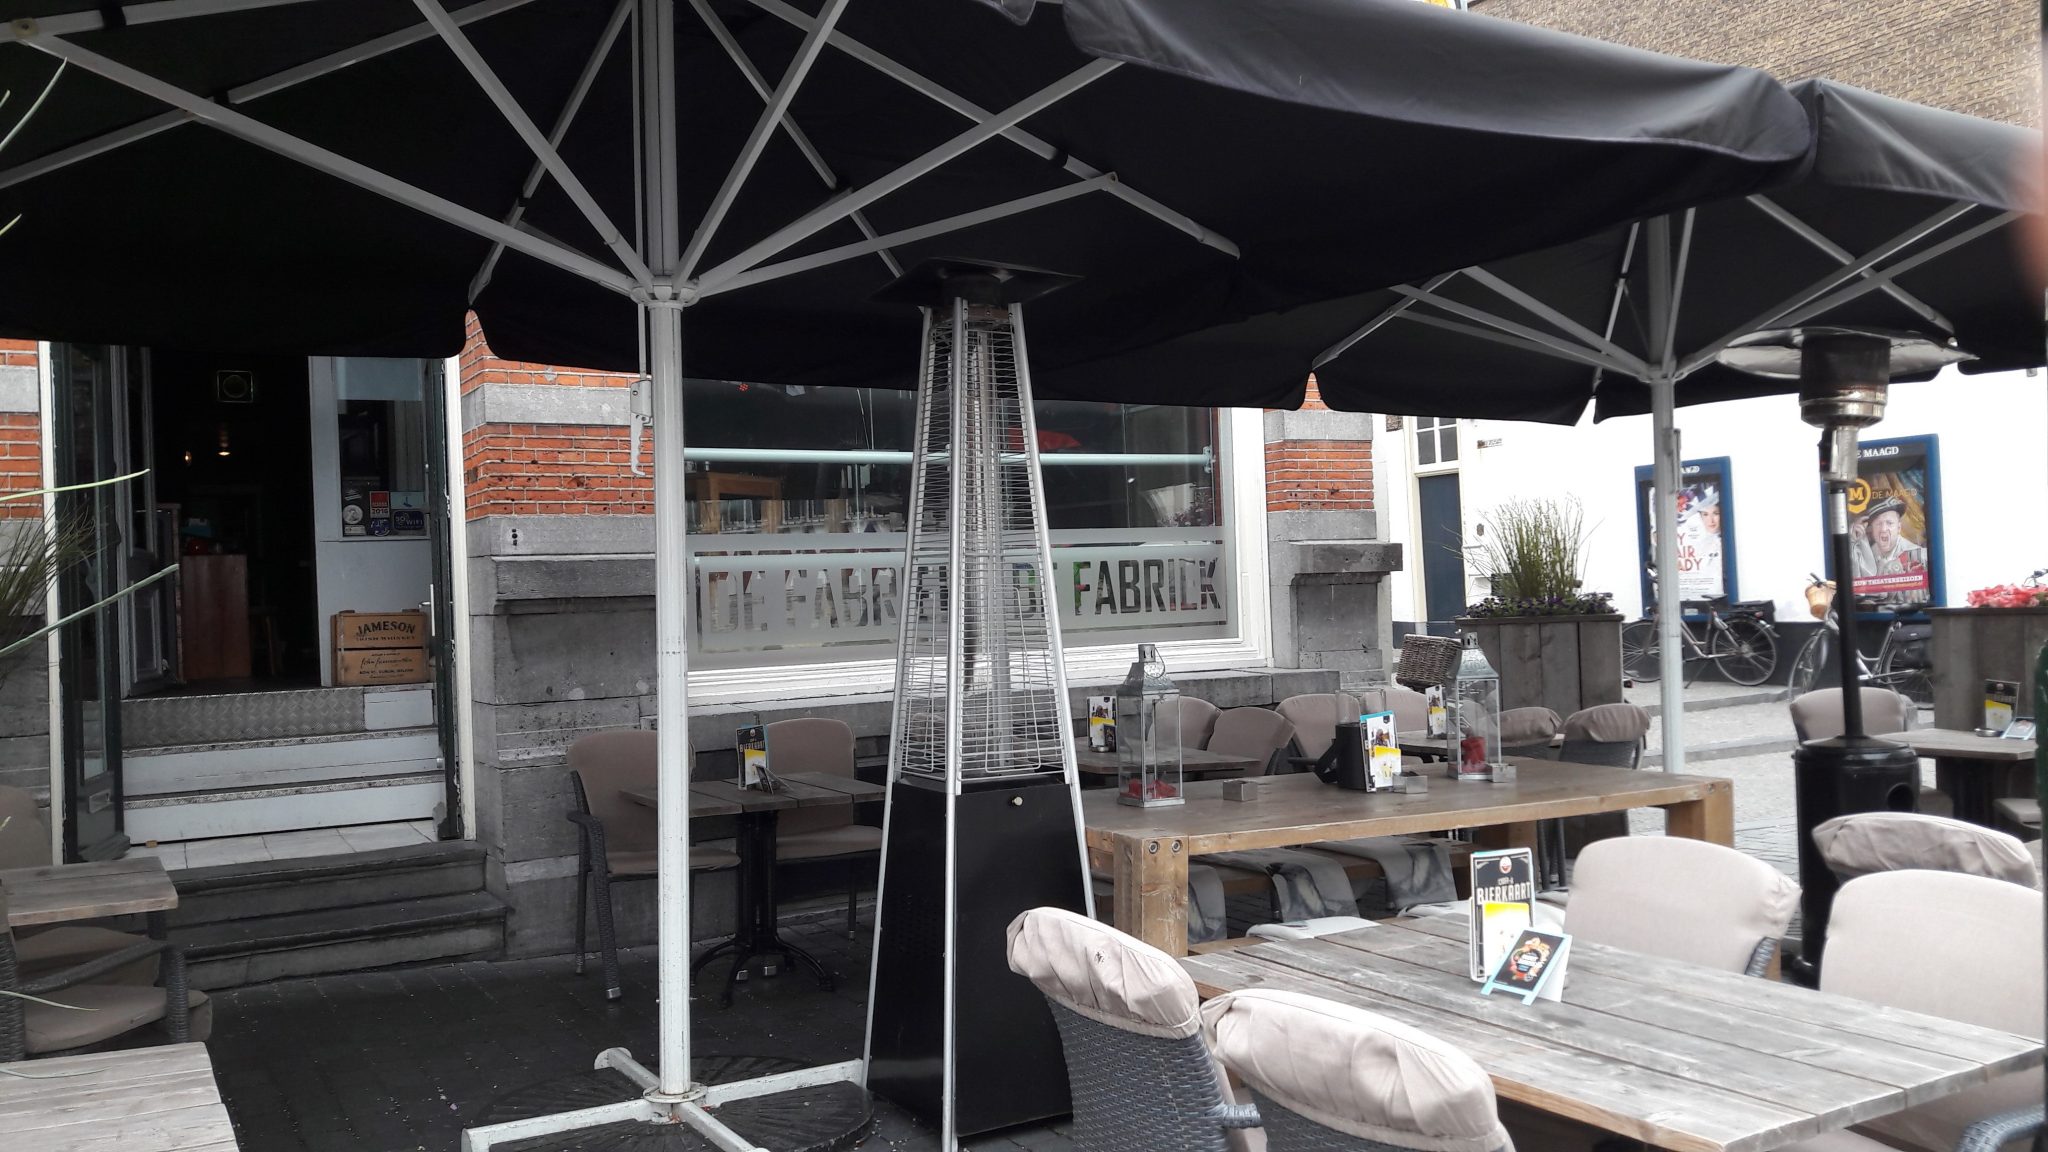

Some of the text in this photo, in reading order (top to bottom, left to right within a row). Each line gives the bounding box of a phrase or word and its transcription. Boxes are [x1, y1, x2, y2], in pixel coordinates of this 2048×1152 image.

[1863, 446, 1899, 458] MAAGD
[1848, 487, 1865, 501] M
[1872, 488, 1917, 499] DE MAAGD
[709, 571, 768, 633] DE
[357, 621, 416, 637] JAMESON
[1477, 882, 1531, 905] BIERKAART
